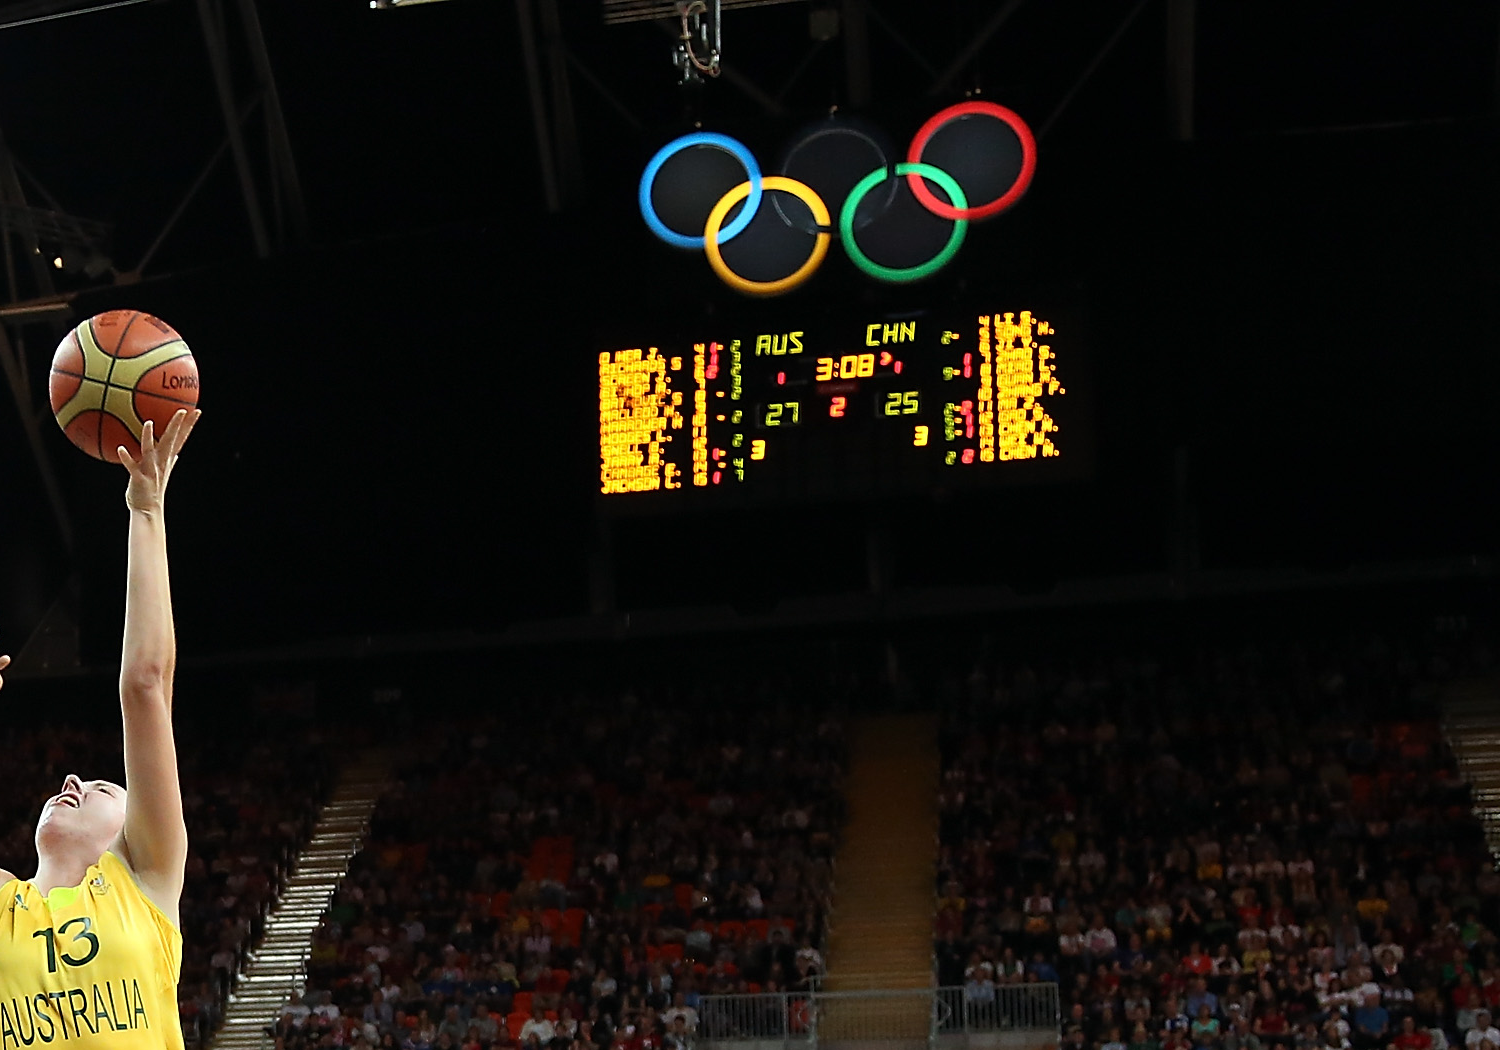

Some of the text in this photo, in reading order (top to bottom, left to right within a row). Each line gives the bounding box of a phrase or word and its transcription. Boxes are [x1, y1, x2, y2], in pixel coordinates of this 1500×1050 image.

[755, 332, 804, 356] AUS
[866, 321, 915, 346] CHN
[816, 354, 874, 381] 3:08
[765, 402, 799, 426] 27
[830, 397, 847, 418] 2
[885, 391, 918, 415] 25
[914, 426, 928, 446] 3
[750, 440, 765, 460] 3
[32, 917, 100, 973] 13
